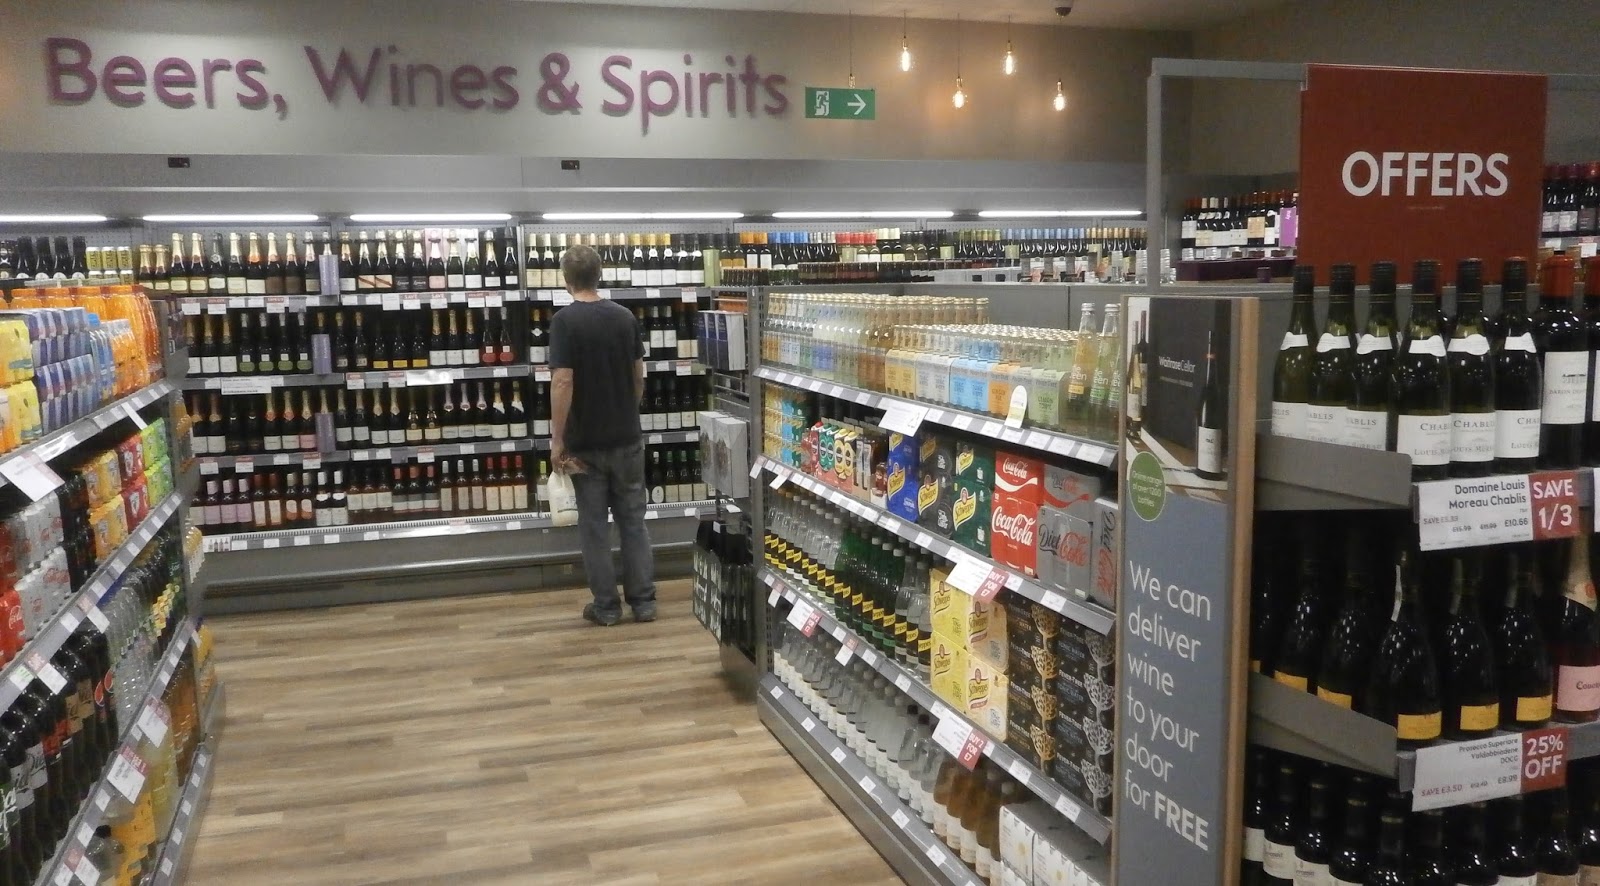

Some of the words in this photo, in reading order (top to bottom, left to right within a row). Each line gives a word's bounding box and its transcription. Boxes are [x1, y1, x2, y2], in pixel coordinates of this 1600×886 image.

[46, 37, 287, 119] Beers,
[304, 45, 520, 112] Wines
[538, 52, 583, 114] &
[601, 54, 789, 134] Spirits
[1341, 151, 1509, 197] OFFERS
[1455, 481, 1499, 495] Domaine
[1501, 479, 1525, 491] Louis
[1532, 478, 1574, 499] SAVE
[1449, 496, 1489, 509] Moreau
[1490, 493, 1527, 506] Chablis
[992, 505, 1036, 546] Coca-Cola
[1423, 517, 1440, 525] SAVE
[1504, 517, 1529, 527] £10.66
[1538, 504, 1573, 531] 1/3
[1129, 560, 1161, 601] We
[1166, 583, 1211, 622] can
[1128, 605, 1201, 662] deliver
[1127, 652, 1174, 697] wine
[1127, 687, 1146, 724] to
[1149, 708, 1199, 753] your
[1458, 743, 1487, 753] Prosecco
[1488, 737, 1518, 749] Superiore
[1526, 734, 1564, 756] 25%
[1126, 735, 1174, 783] door
[1524, 754, 1562, 779] OFF
[1421, 787, 1440, 797] SAVE
[1441, 784, 1463, 794] £3.50
[1125, 769, 1151, 812] for
[1155, 790, 1209, 852] FREE
